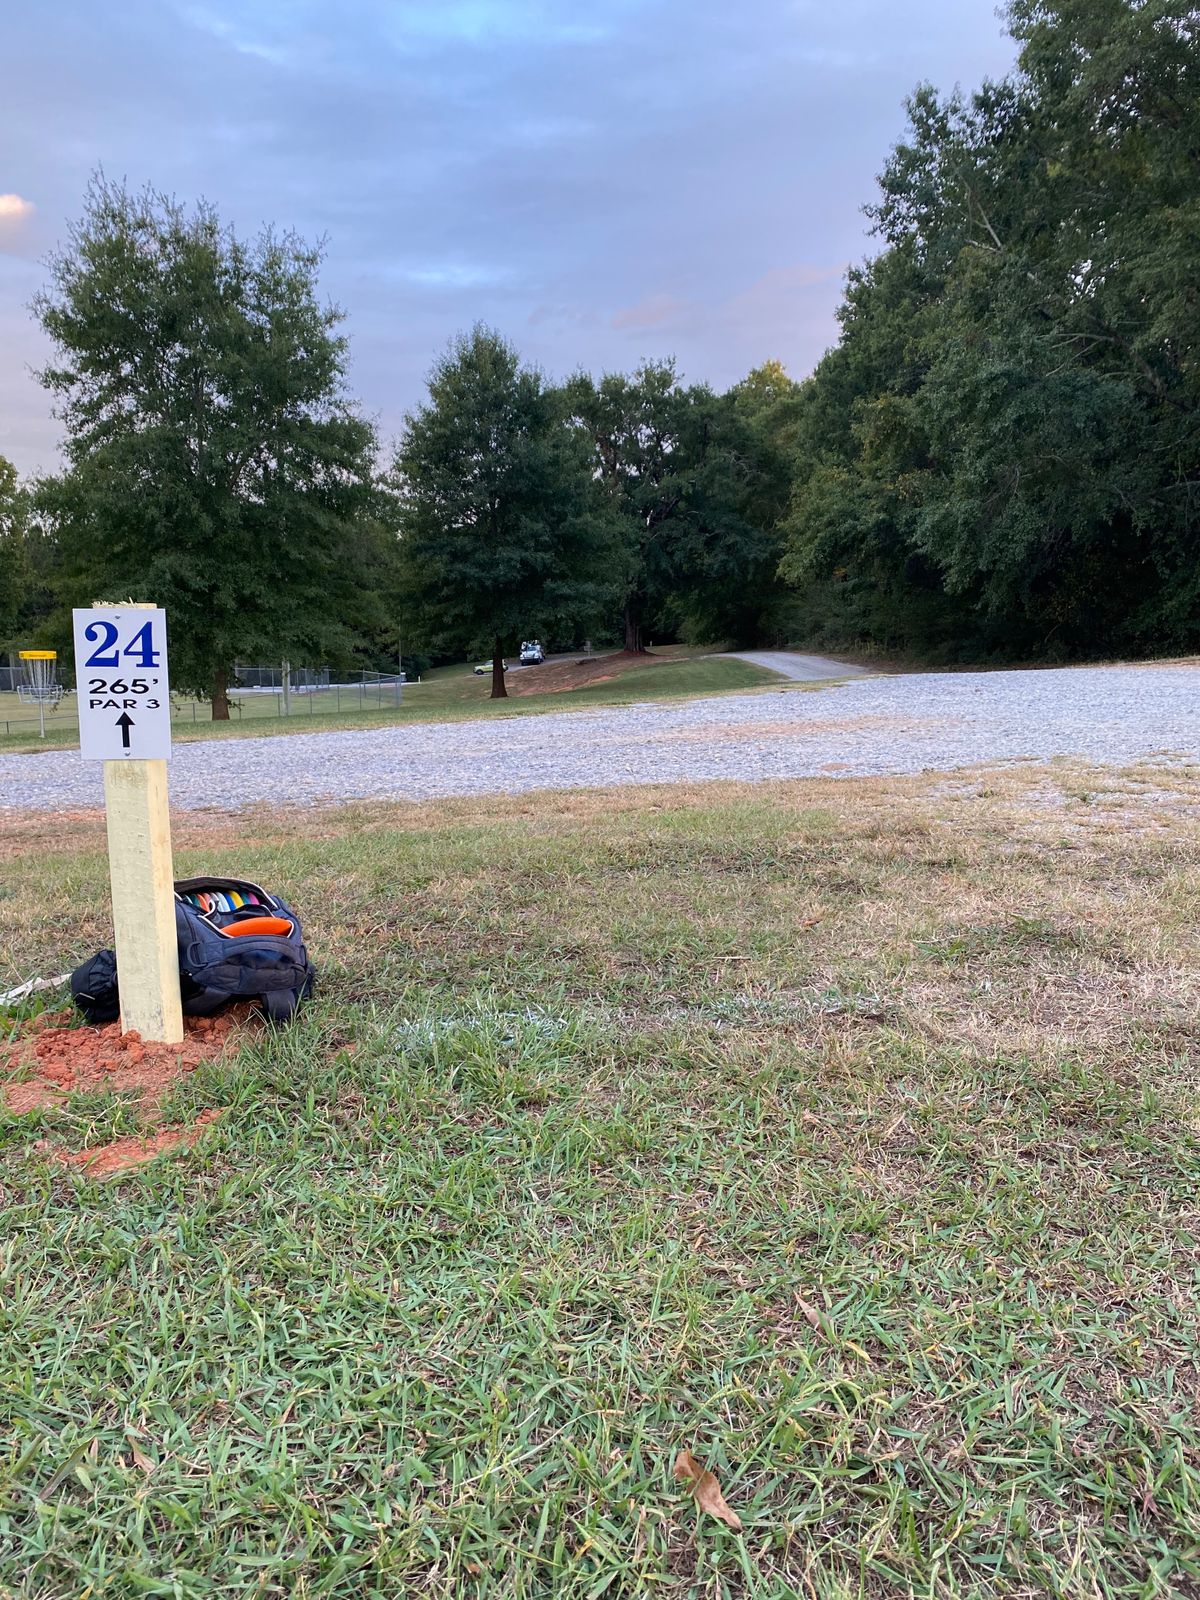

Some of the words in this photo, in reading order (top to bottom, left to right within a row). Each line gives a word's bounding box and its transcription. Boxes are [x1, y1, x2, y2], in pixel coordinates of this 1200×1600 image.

[85, 621, 160, 668] 24
[88, 679, 159, 695] 265'
[89, 699, 137, 709] PAR
[146, 699, 161, 709] 3
